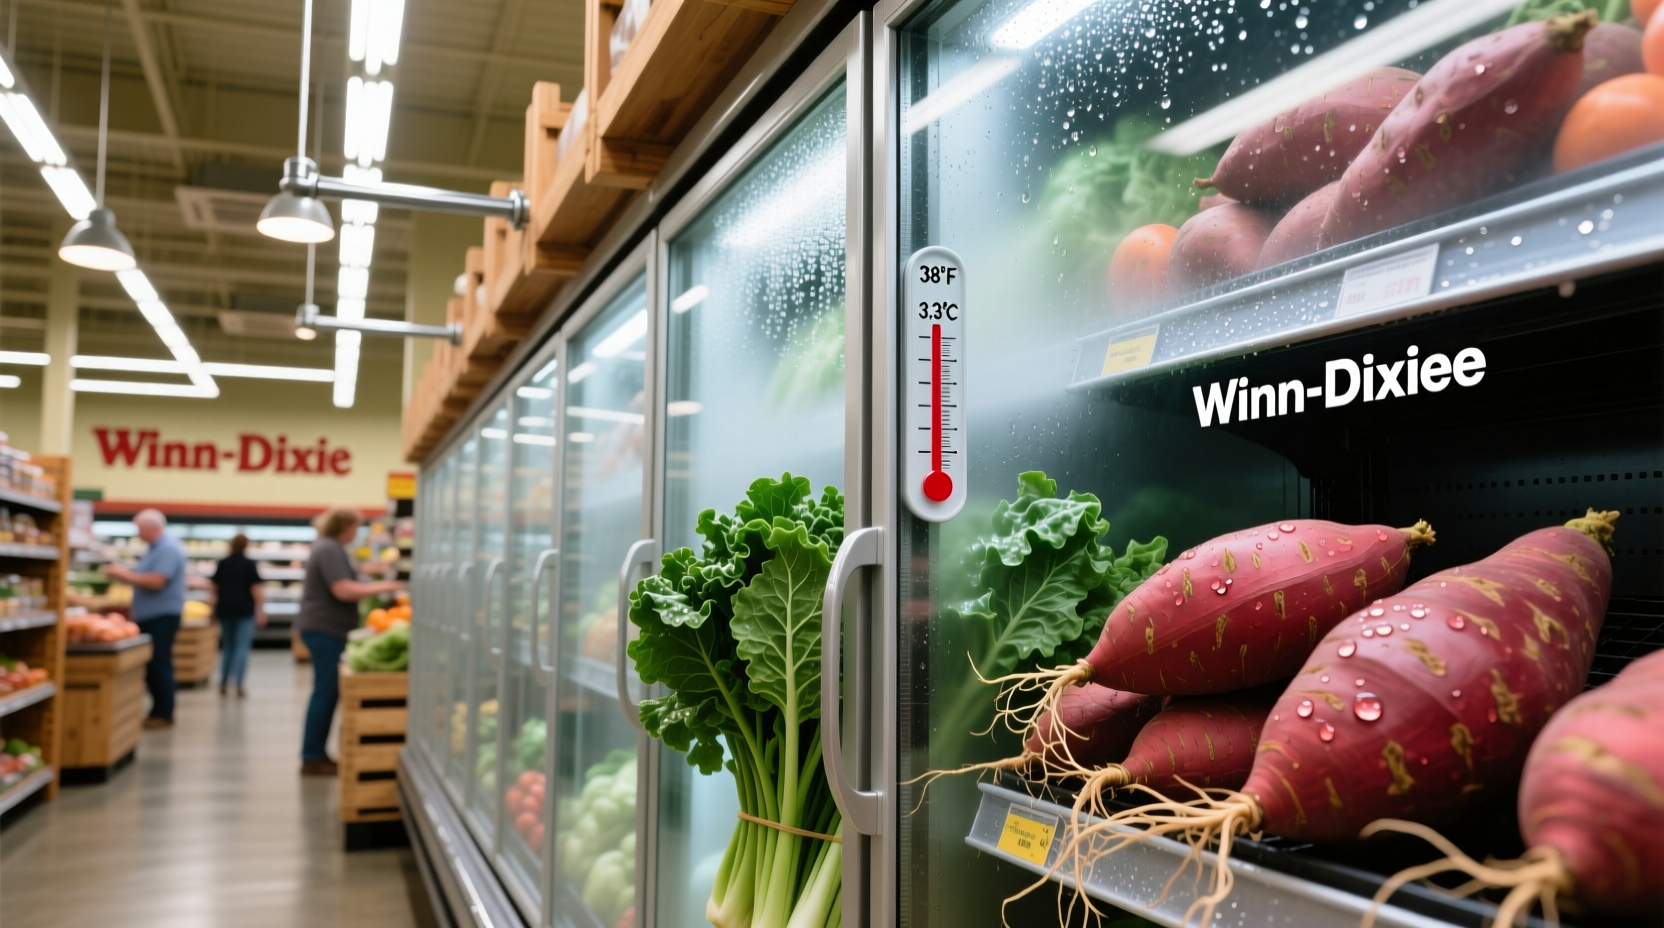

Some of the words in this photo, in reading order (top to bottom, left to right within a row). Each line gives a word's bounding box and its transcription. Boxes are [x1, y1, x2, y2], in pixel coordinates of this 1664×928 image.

[920, 265, 957, 285] 38°F
[1192, 345, 1487, 428] Winn-Dixiee
[94, 427, 352, 476] Winn-Dixie
